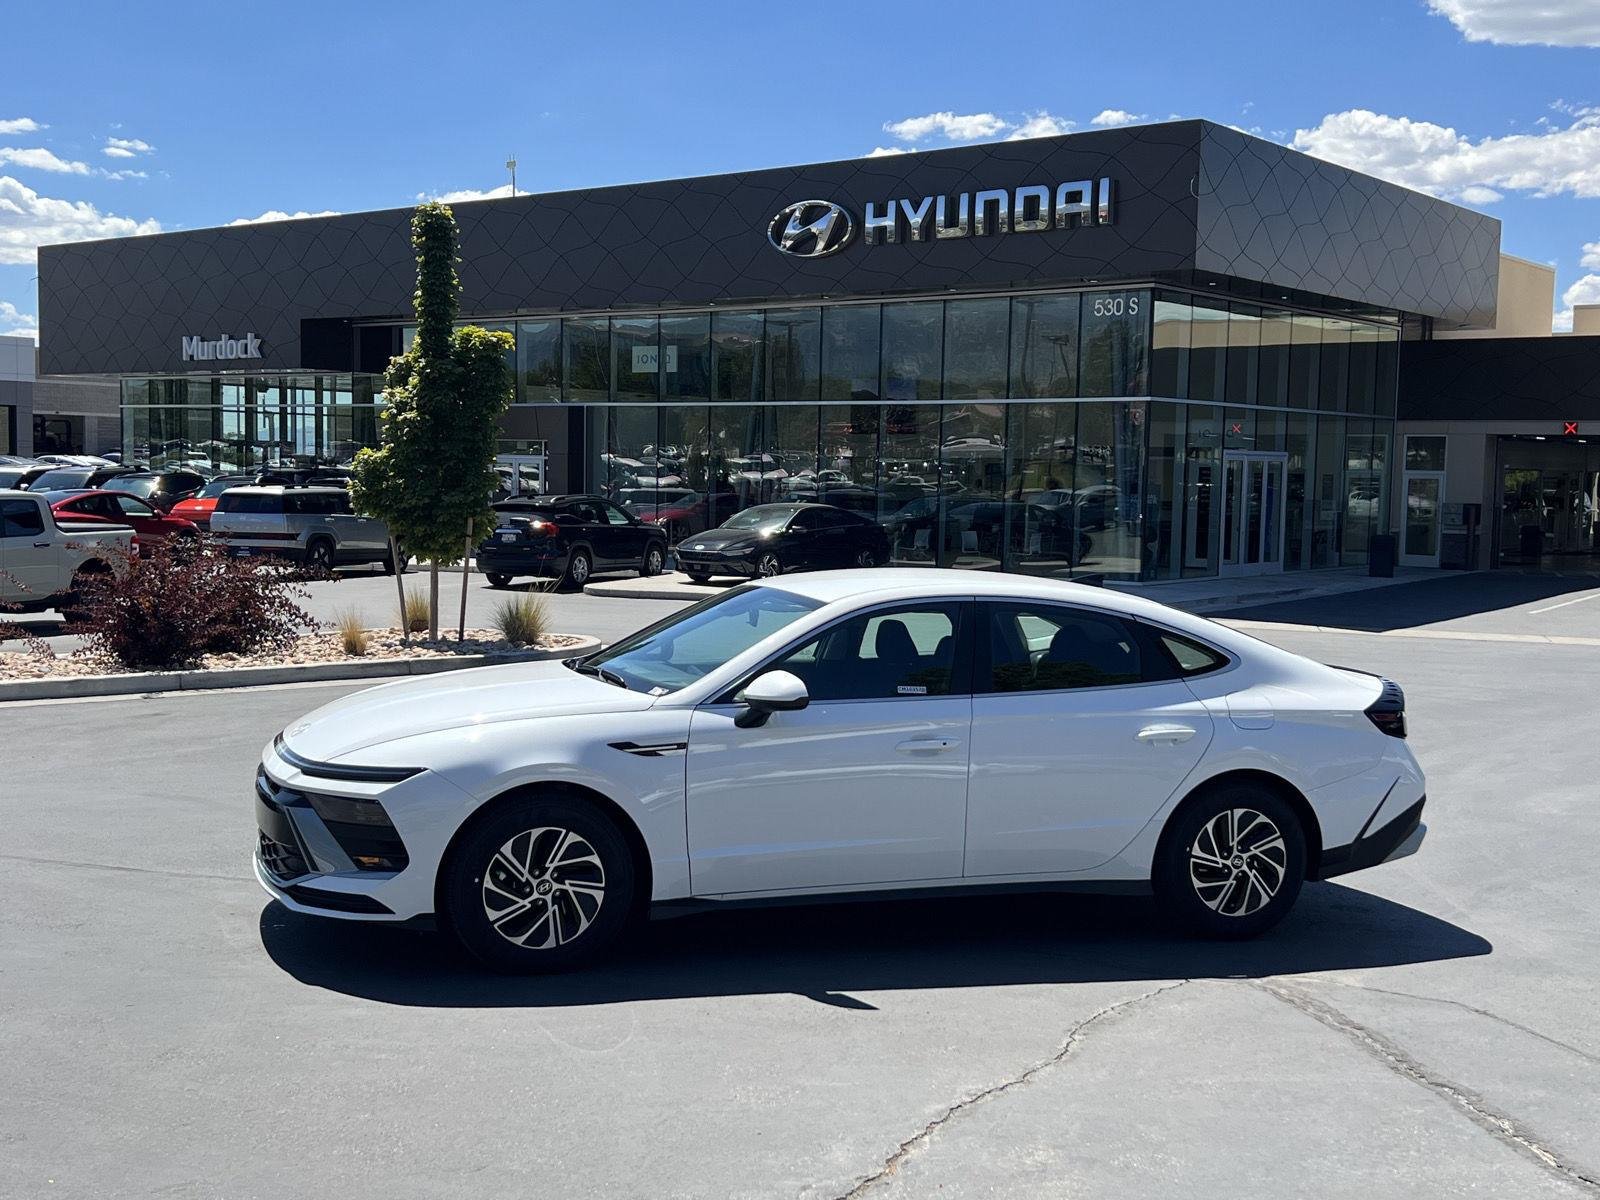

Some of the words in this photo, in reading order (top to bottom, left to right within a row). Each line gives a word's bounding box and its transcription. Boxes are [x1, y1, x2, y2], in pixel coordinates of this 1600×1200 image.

[864, 177, 1111, 245] HYUNDAI
[1093, 298, 1124, 317] 530
[1128, 297, 1139, 315] S
[182, 332, 262, 361] Murdock
